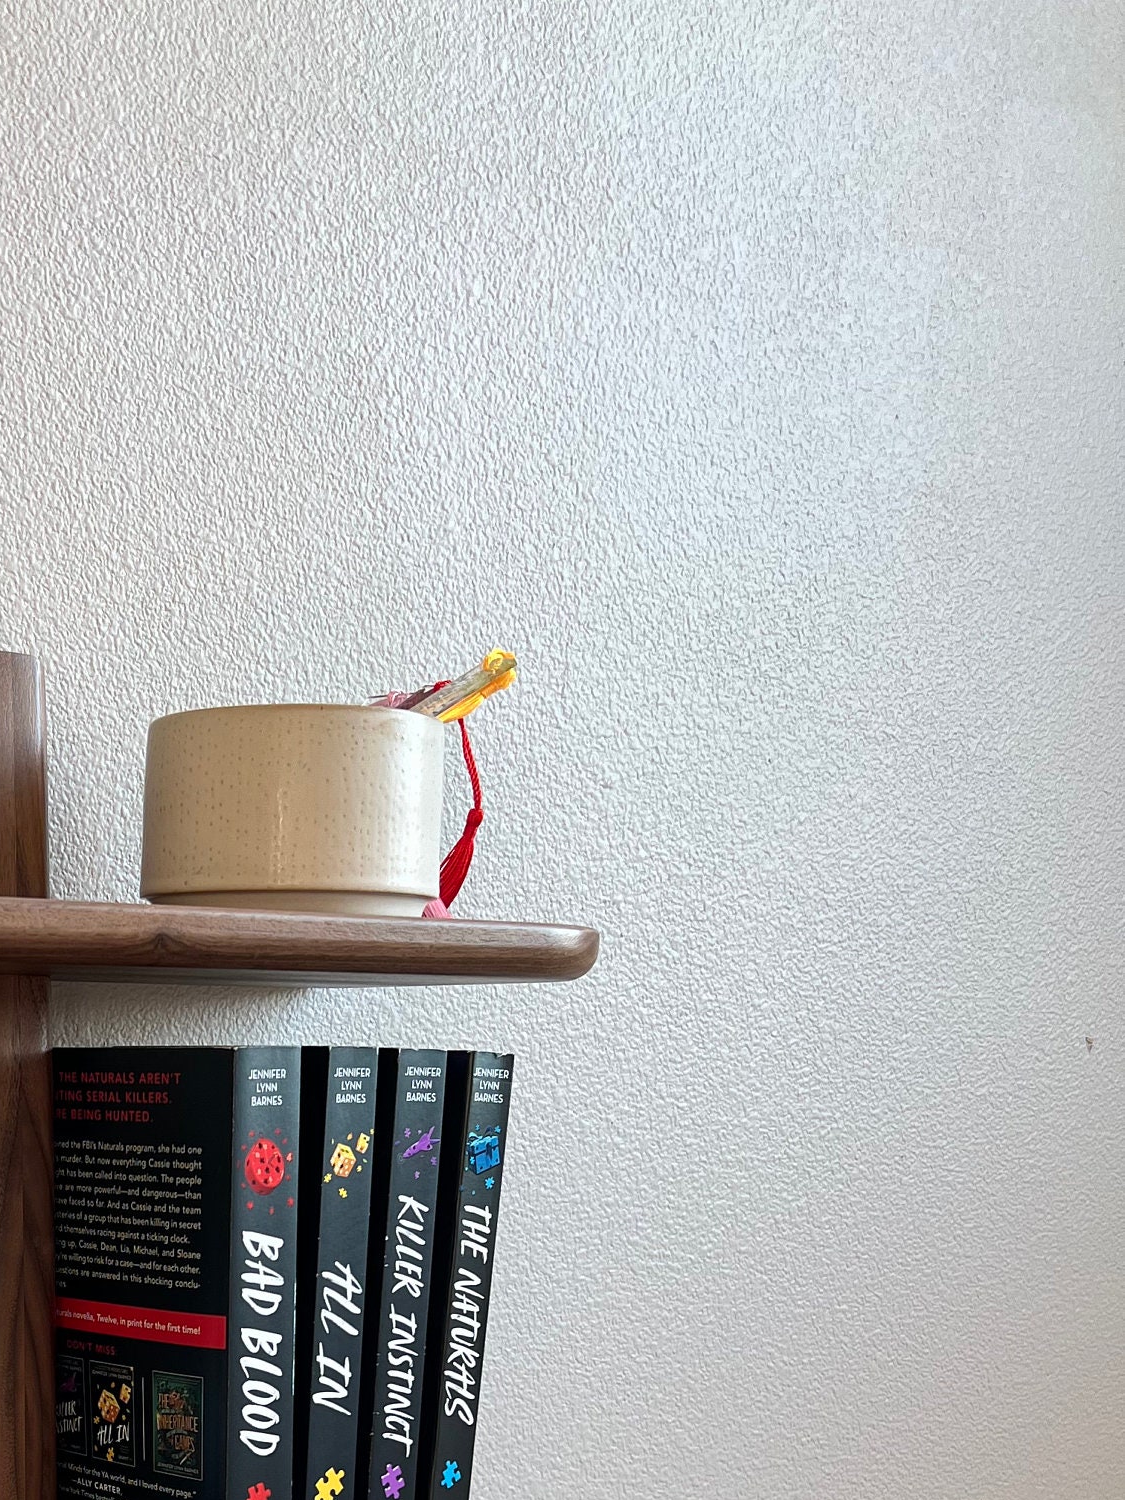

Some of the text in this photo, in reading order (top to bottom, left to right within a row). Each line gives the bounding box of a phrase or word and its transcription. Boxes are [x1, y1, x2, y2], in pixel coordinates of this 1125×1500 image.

[248, 1069, 287, 1080] JENNIFER
[334, 1067, 371, 1078] JENNIFER
[404, 1066, 442, 1077] JENNIFER
[473, 1067, 510, 1079] JENNIFER
[59, 1072, 181, 1085] THE NATURALS AREN'T
[411, 1080, 433, 1089] LYNN
[256, 1082, 278, 1093] LYNN
[341, 1081, 363, 1090] LYNN
[479, 1081, 500, 1091] LYNN
[86, 1091, 121, 1103] SERIAL
[125, 1092, 173, 1105] KILLERS.
[251, 1095, 283, 1106] BARNES
[335, 1093, 366, 1104] BARNES
[406, 1092, 436, 1102] BARNES
[474, 1092, 504, 1104] BARNES
[70, 1109, 102, 1121] BEING
[105, 1110, 154, 1123] HUNTED.
[70, 1140, 81, 1150] the
[98, 1141, 124, 1152] Naturals
[158, 1143, 170, 1154] she
[171, 1144, 186, 1154] had
[187, 1146, 202, 1155] one
[85, 1155, 96, 1165] But
[97, 1157, 111, 1165] now
[112, 1158, 146, 1170] everything
[148, 1158, 171, 1169] Cassie
[172, 1160, 202, 1172] thought
[443, 1204, 493, 1426] THE NATURALS
[120, 1316, 126, 1325] in
[127, 1319, 143, 1330] print
[143, 1319, 154, 1329] for
[155, 1320, 166, 1331] the
[167, 1322, 181, 1333] first
[182, 1325, 201, 1336] time!
[382, 1194, 430, 1458] KILLER INSTINCT
[239, 1230, 284, 1457] BAD BLOOD
[311, 1260, 363, 1416] ALL IN
[115, 1423, 130, 1443] IN
